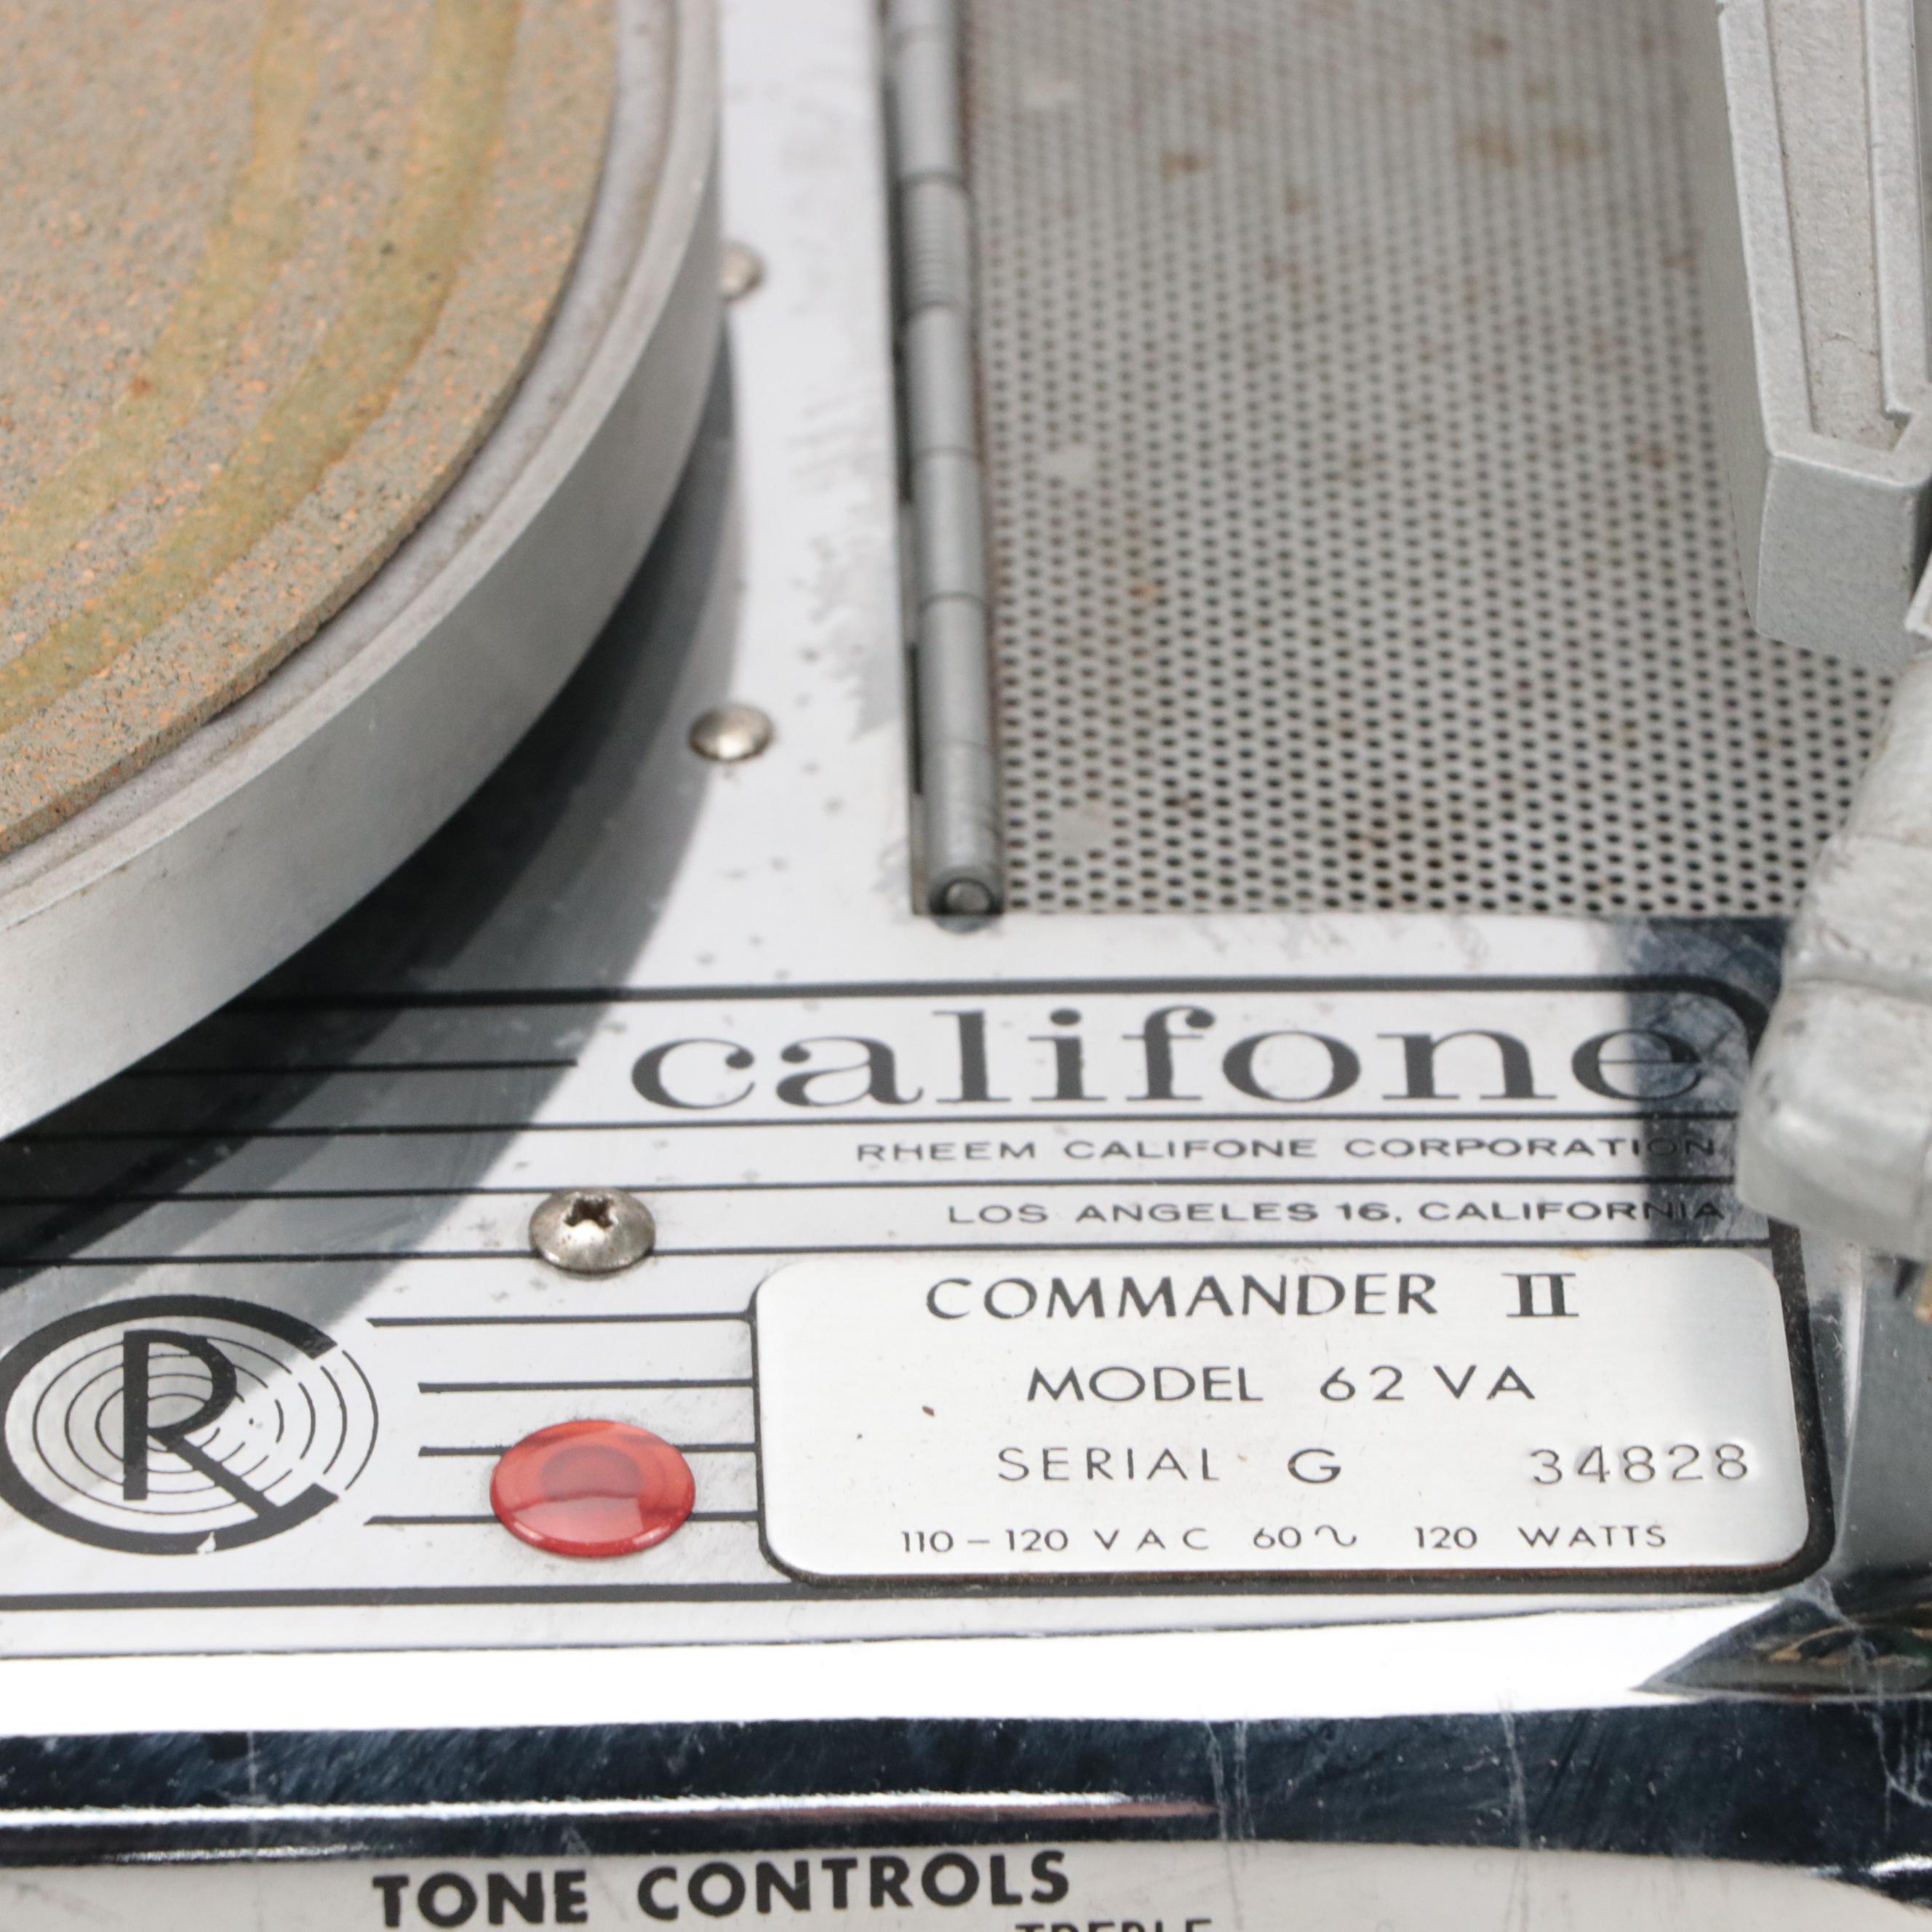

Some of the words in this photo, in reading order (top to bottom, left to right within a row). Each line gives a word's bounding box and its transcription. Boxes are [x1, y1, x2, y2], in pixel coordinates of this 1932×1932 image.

[631, 1006, 1701, 1109] califone
[856, 1141, 1037, 1162] RHEEM
[1063, 1138, 1315, 1159] CALIFONE
[1344, 1136, 1716, 1158] CORPORATION
[948, 1202, 1050, 1225] LOS
[1074, 1202, 1320, 1224] ANGELES
[1336, 1202, 1402, 1224] 16,
[1418, 1200, 1725, 1222] CALIFORNIA
[925, 1272, 1439, 1321] COMMANDER
[1506, 1272, 1580, 1319] II
[1026, 1365, 1264, 1403] MODEL
[1319, 1365, 1405, 1402] 62
[1432, 1364, 1536, 1401] VA
[997, 1446, 1218, 1482] SERIAL
[1287, 1447, 1342, 1485] G
[1529, 1442, 1749, 1486] 34828
[1517, 1524, 1666, 1549] WATTS
[370, 1867, 589, 1930] TONE
[636, 1850, 1071, 1922] CONTROLS
